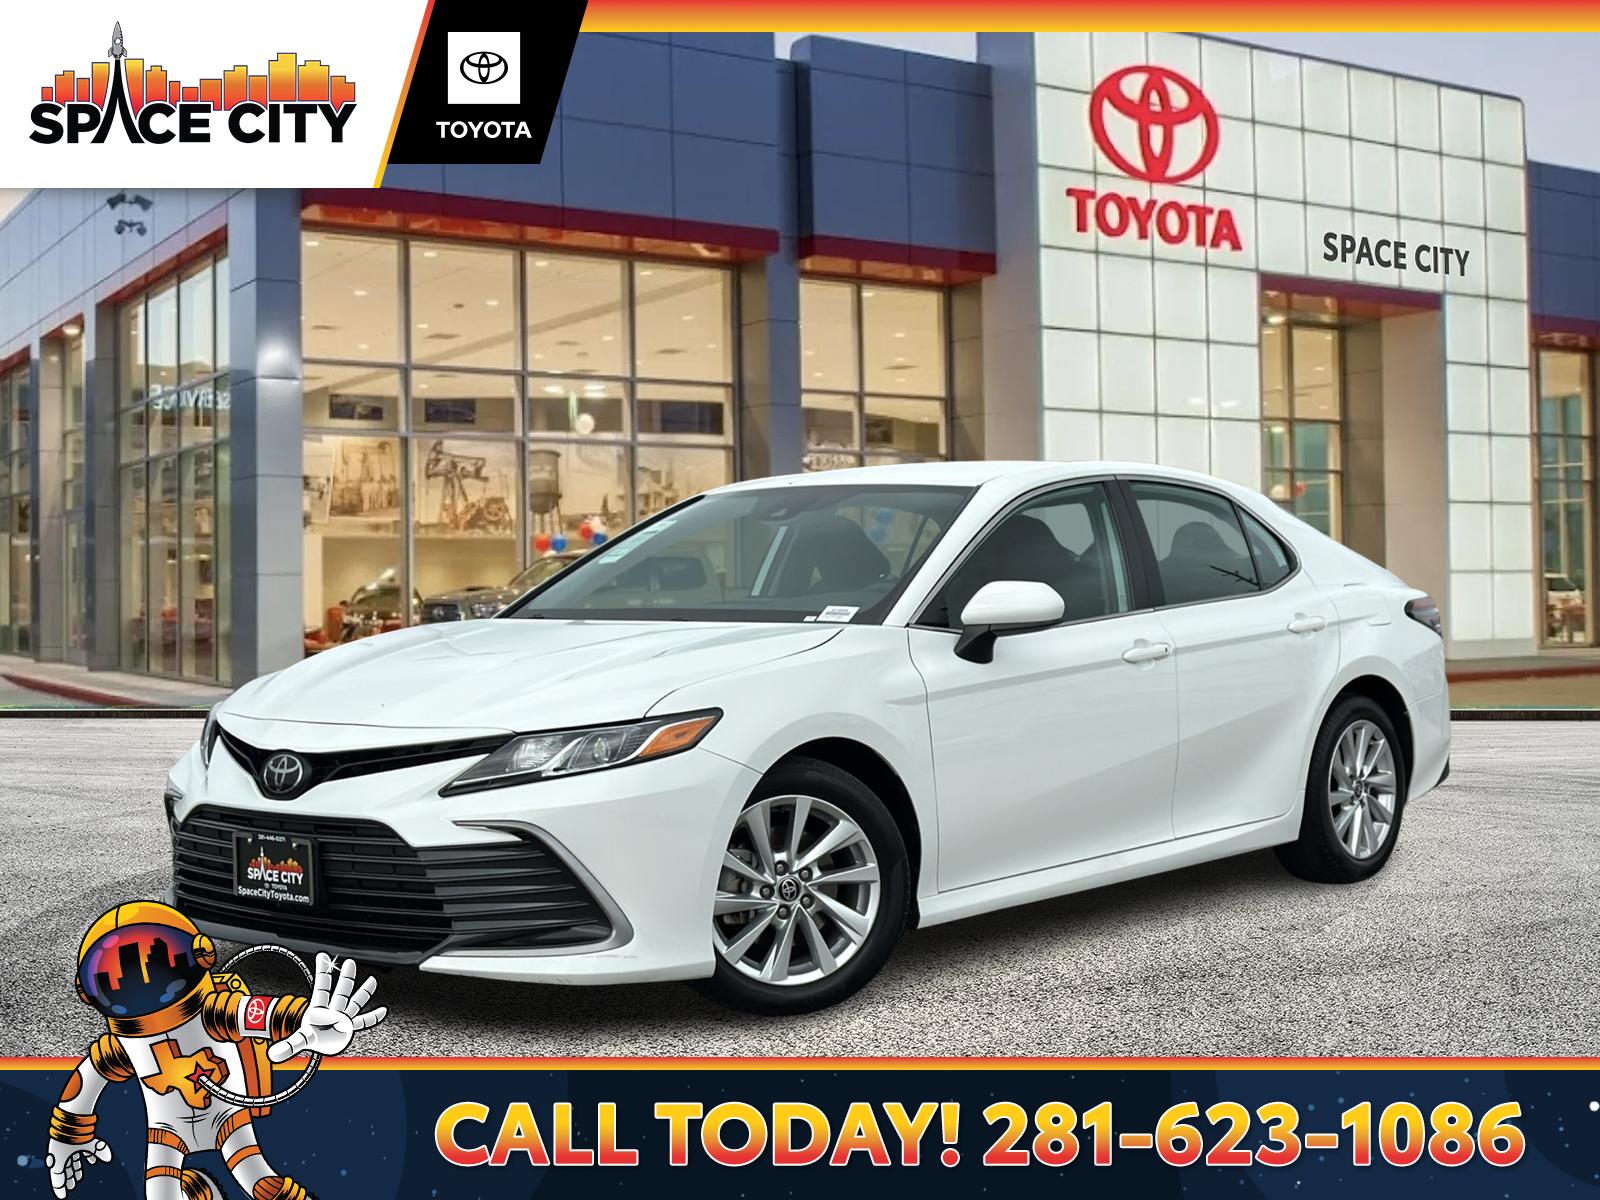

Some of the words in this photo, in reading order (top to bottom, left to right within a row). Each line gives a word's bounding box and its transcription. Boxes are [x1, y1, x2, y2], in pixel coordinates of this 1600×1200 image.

[1066, 187, 1243, 251] TOYOTA
[1323, 232, 1407, 270] SPACE
[1414, 244, 1470, 277] CITY
[281, 871, 304, 885] CITY
[238, 886, 309, 903] SpaceCityToyota.com
[271, 883, 287, 891] TOYOTA
